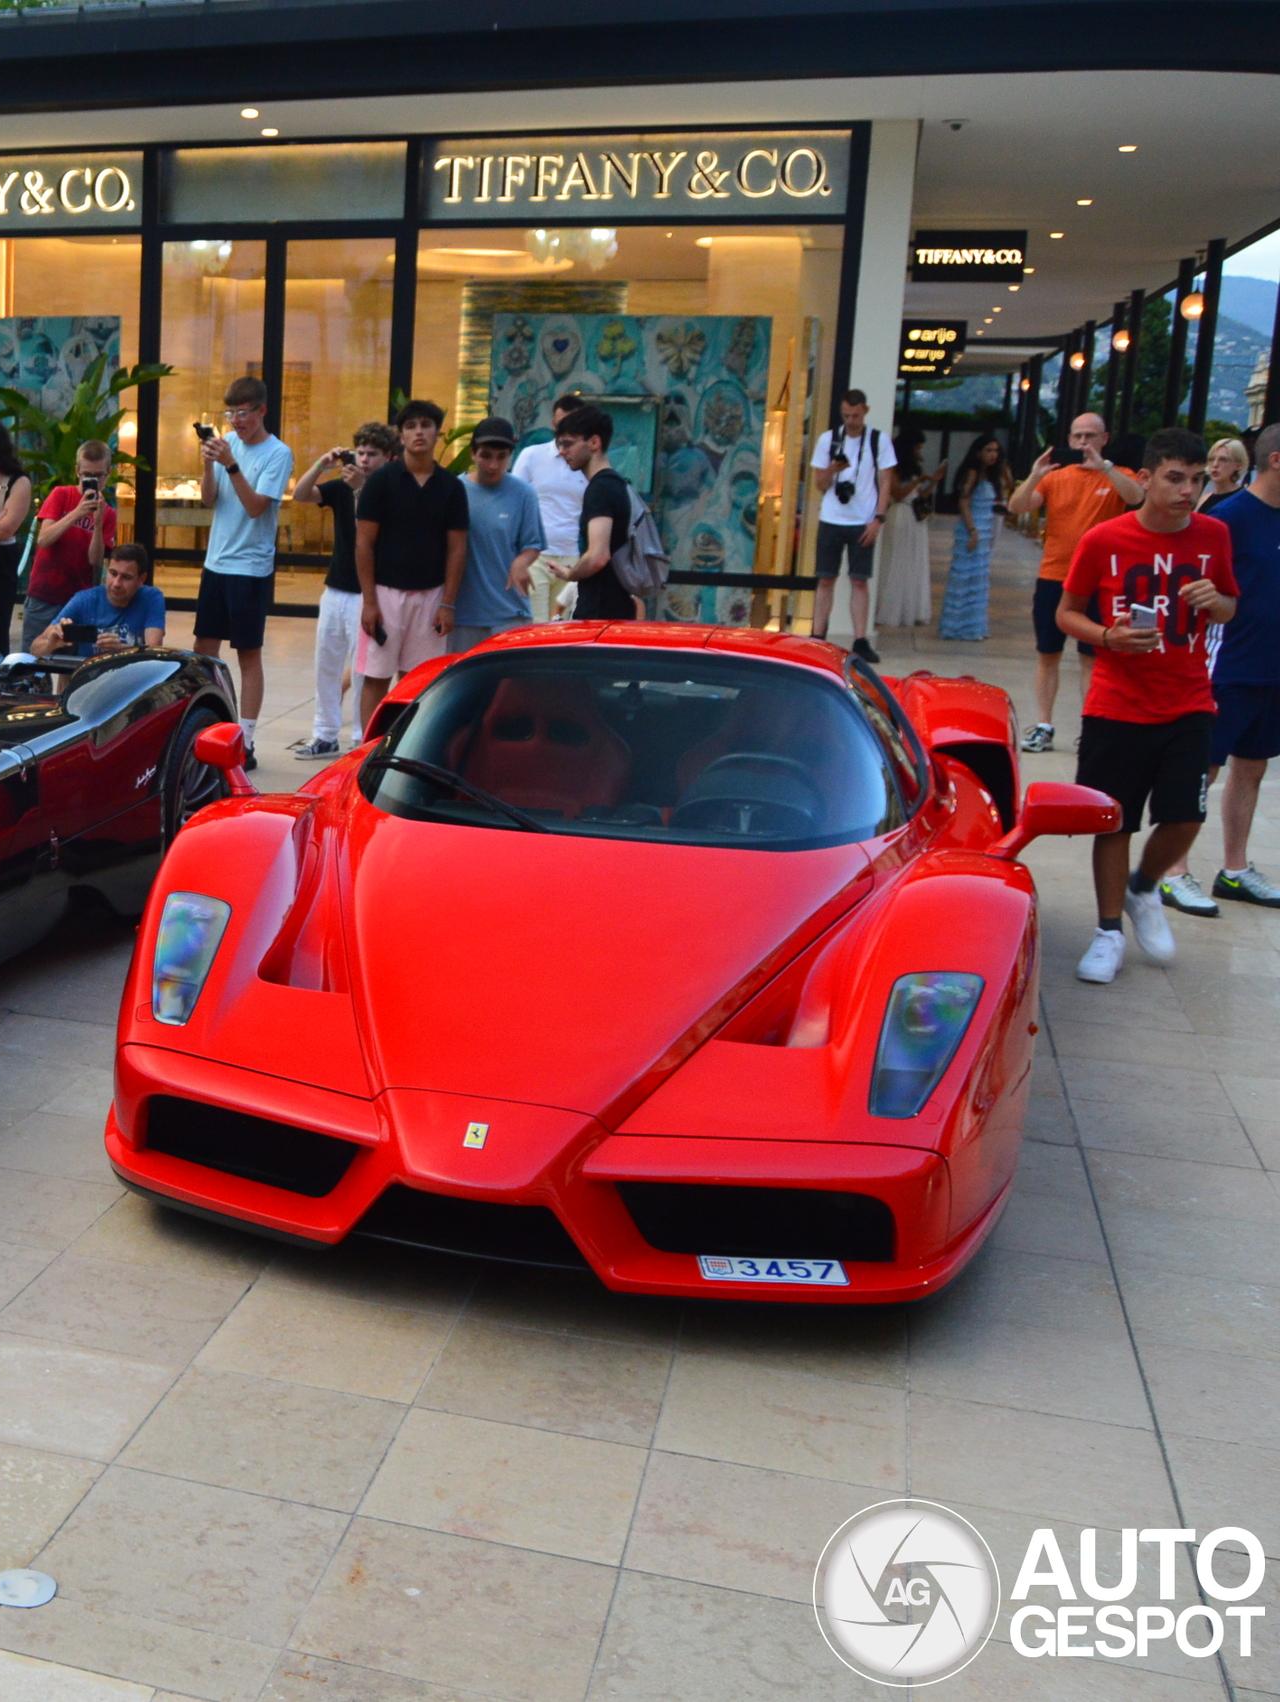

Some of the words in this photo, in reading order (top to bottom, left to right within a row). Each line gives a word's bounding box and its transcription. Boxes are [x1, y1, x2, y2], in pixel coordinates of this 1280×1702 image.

[434, 147, 832, 203] TIFFANY&CO.
[916, 248, 1023, 265] TIFFANY&CO.
[737, 1259, 835, 1280] 3457
